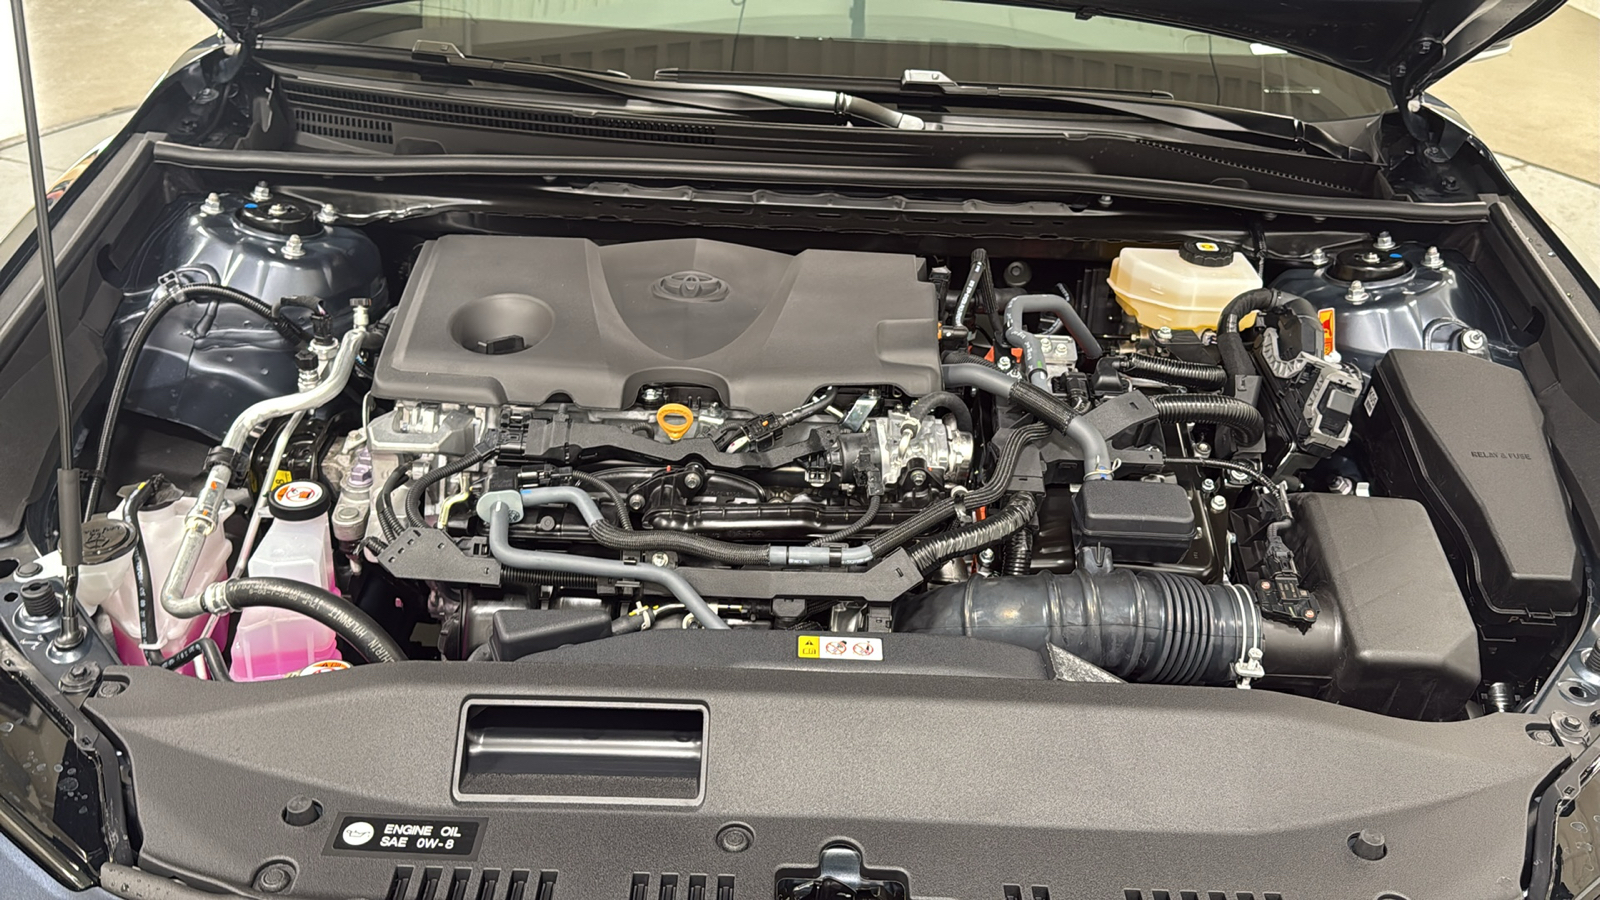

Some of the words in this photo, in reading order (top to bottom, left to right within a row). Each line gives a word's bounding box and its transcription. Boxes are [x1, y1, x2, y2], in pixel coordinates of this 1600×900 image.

[368, 639, 394, 663] HIRIN
[383, 824, 433, 836] ENGINE
[440, 827, 461, 837] OIL
[380, 837, 408, 847] SAE
[416, 838, 454, 849] 0W-8
